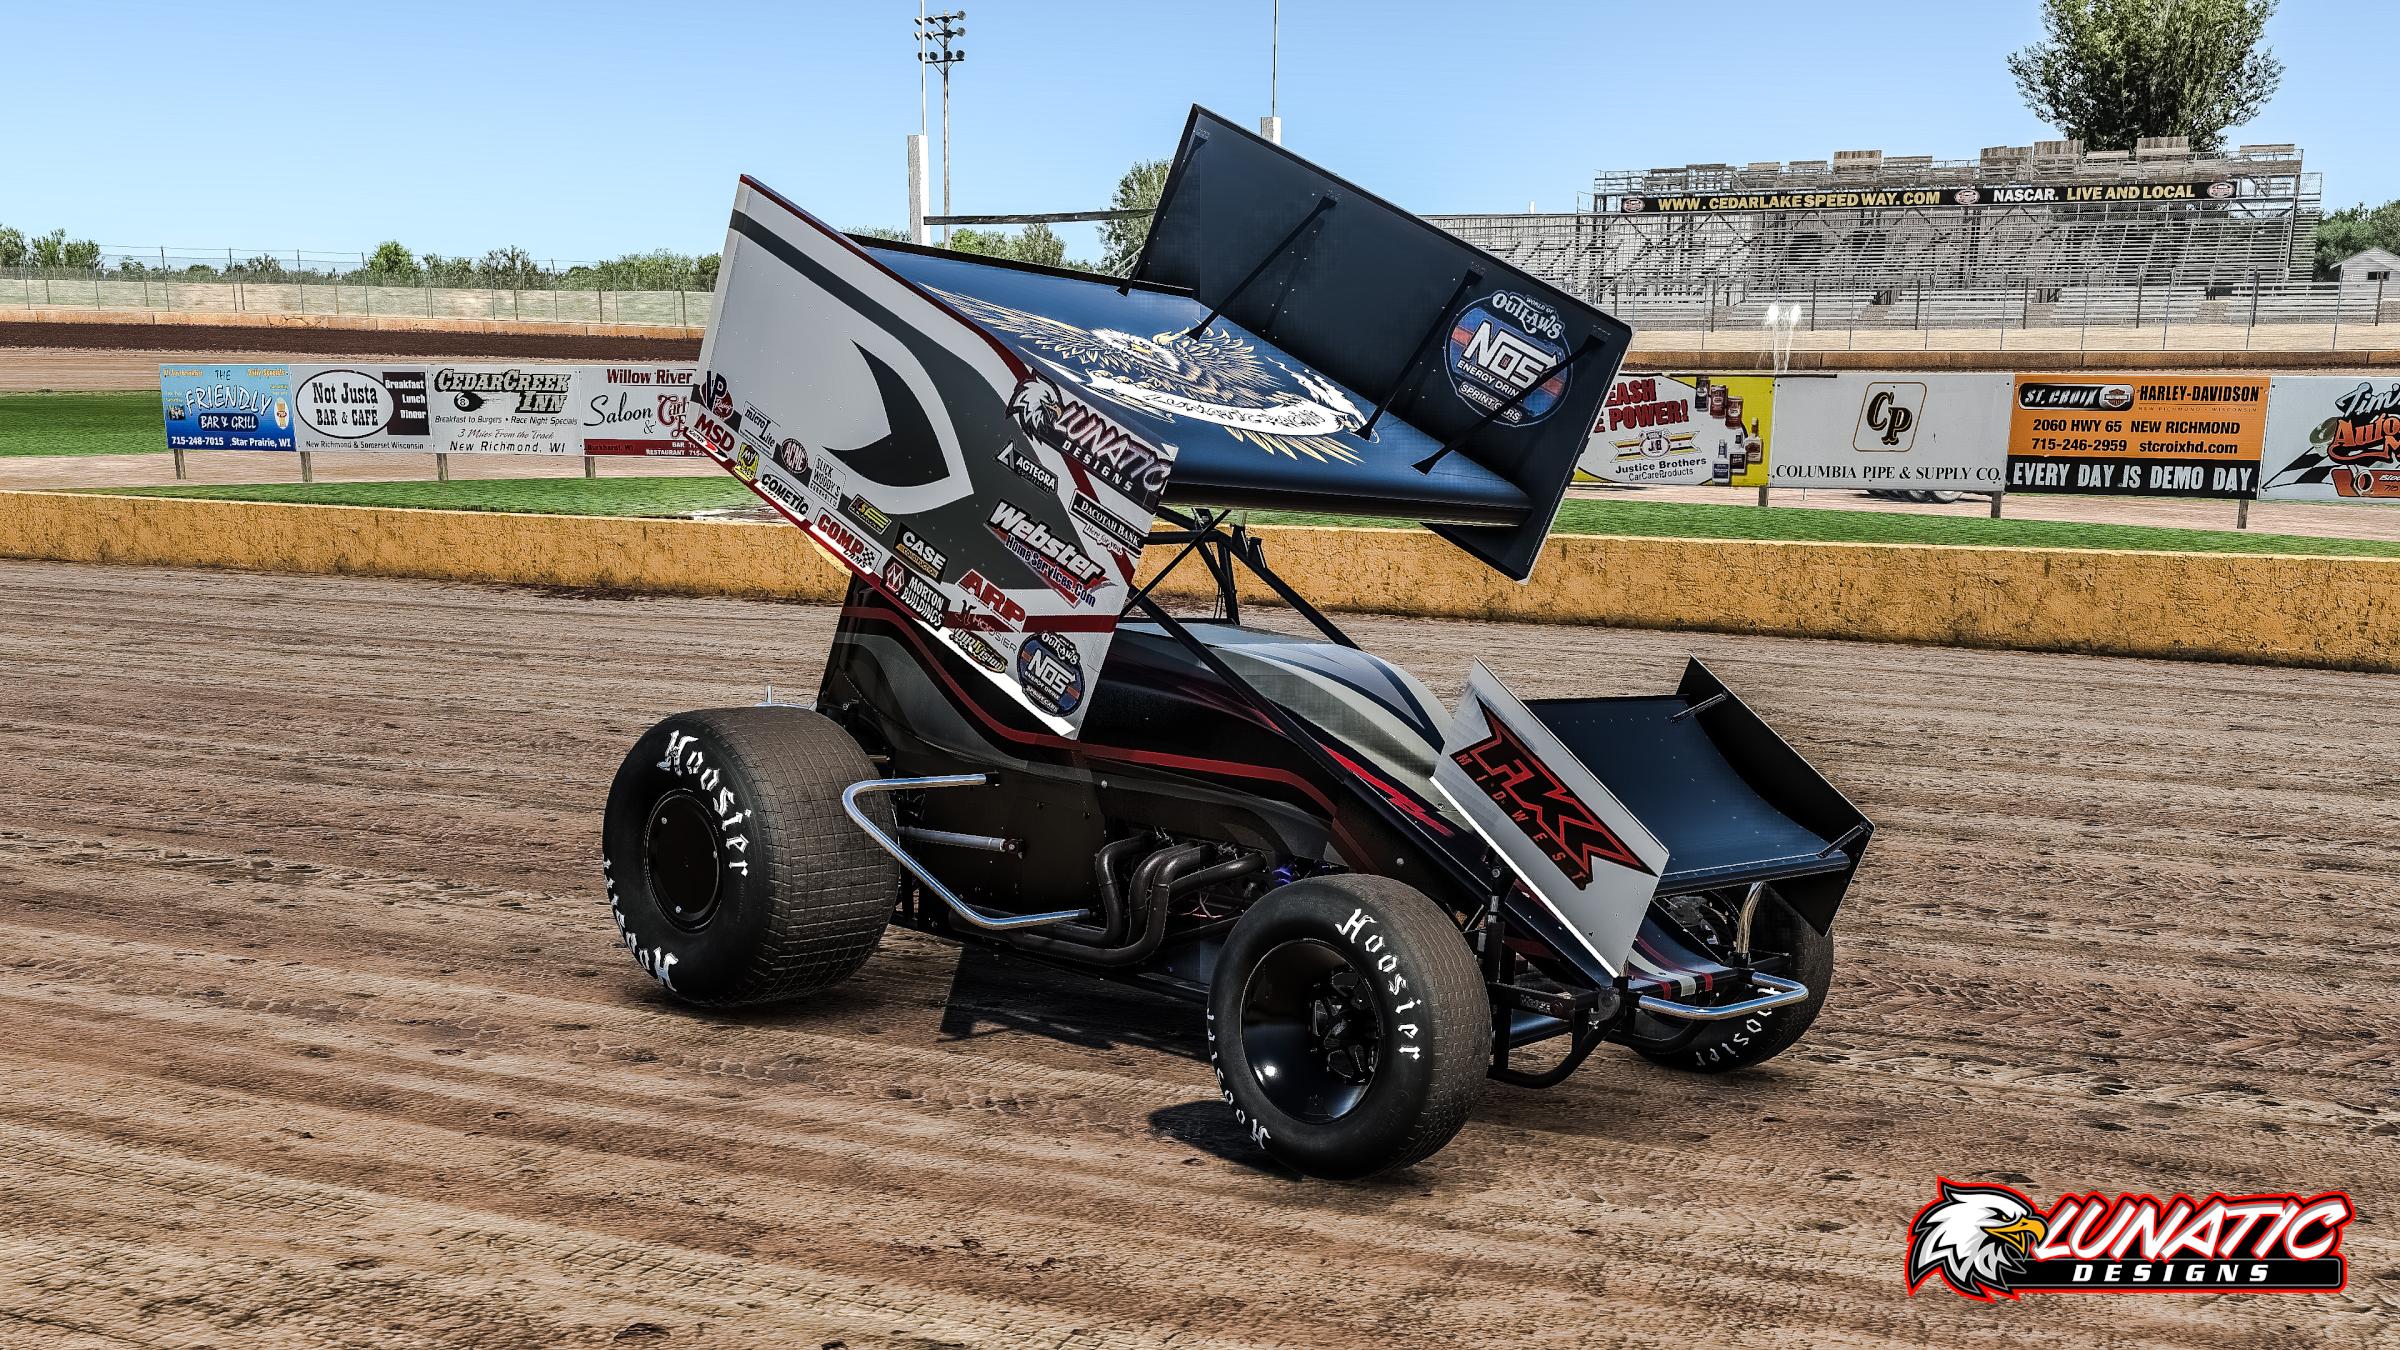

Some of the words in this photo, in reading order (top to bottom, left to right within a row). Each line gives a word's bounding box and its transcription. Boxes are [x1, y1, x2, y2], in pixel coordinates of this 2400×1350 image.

[2067, 186, 2102, 200] LIVE
[2106, 186, 2140, 200] AND
[2142, 185, 2195, 200] LOCAL
[1462, 320, 1557, 390] NOS
[215, 369, 231, 381] THE
[384, 379, 425, 390] Breakfast
[606, 368, 652, 384] Willow
[655, 369, 693, 384] River
[1457, 360, 1496, 384] ENERGY
[1494, 381, 1521, 400] DRIN
[185, 383, 273, 417] FRIENDLY
[312, 382, 338, 404] Not
[341, 382, 379, 404] Justa
[402, 394, 426, 404] Lunch
[515, 391, 568, 414] INN
[1460, 384, 1495, 407] SPRINT
[1494, 401, 1521, 421] CRS
[2048, 388, 2101, 408] CROIX
[316, 408, 338, 426] BAR
[341, 411, 349, 424] &
[400, 409, 427, 419] Dinner
[584, 391, 654, 427] Saloon
[1609, 399, 1690, 432] POWER!
[201, 415, 220, 429] BAR
[231, 416, 257, 430] GRILL
[434, 415, 467, 424] Breakfast
[468, 416, 476, 424] to
[477, 416, 503, 425] Burgers
[510, 416, 528, 424] Race
[529, 416, 548, 426] Night
[550, 416, 578, 427] Specials
[643, 420, 657, 434] &
[694, 413, 736, 452] MSD
[2033, 419, 2067, 432] 2060
[2070, 419, 2102, 432] HWY
[2105, 420, 2122, 433] 65
[2130, 420, 2161, 434] NEW
[2165, 421, 2241, 434] RICHMOND
[171, 436, 224, 446] 715-248-7015
[231, 437, 248, 447] Star
[278, 438, 292, 447] WI
[306, 440, 320, 448] New
[320, 440, 352, 449] Richmond
[353, 441, 359, 449] &
[360, 441, 390, 449] Somerset
[390, 442, 424, 450] Wisconsin
[457, 428, 466, 438] 3
[494, 428, 516, 439] From
[516, 429, 530, 439] the
[549, 442, 566, 453] WI
[784, 442, 804, 471] ACME
[1053, 402, 1172, 492] LUNATIC
[2031, 438, 2128, 452] 715-246-2959
[2139, 440, 2238, 454] stcroixhd.com
[816, 458, 834, 478] SLICK
[1016, 456, 1056, 490] AGTEGRA
[1062, 440, 1134, 492] DESIGNS
[1615, 462, 1656, 474] Justice
[1658, 458, 1707, 470] Brothers
[1776, 464, 1857, 479] COLUMBIA
[1862, 465, 1896, 480] PIPE
[1899, 466, 1912, 480] &
[1915, 466, 1973, 480] SUPPLY
[2013, 462, 2071, 486] EVERY
[2078, 464, 2116, 488] DAY
[2121, 464, 2142, 488] IS
[2150, 465, 2204, 490] DEMO
[2212, 467, 2253, 492] DAY
[761, 473, 809, 516] COMETIC
[818, 514, 865, 554] COMP
[990, 501, 1103, 581] Webster
[843, 548, 866, 569] CAMS
[902, 531, 946, 571] CASE
[908, 576, 944, 612] MORTON
[958, 571, 1026, 626] ARP
[900, 588, 944, 628] BUILDINGS
[1027, 648, 1076, 695] NOS
[656, 729, 752, 878] Hoosier
[1456, 753, 1587, 881] MIDWEST
[1334, 907, 1423, 1061] Hoosier
